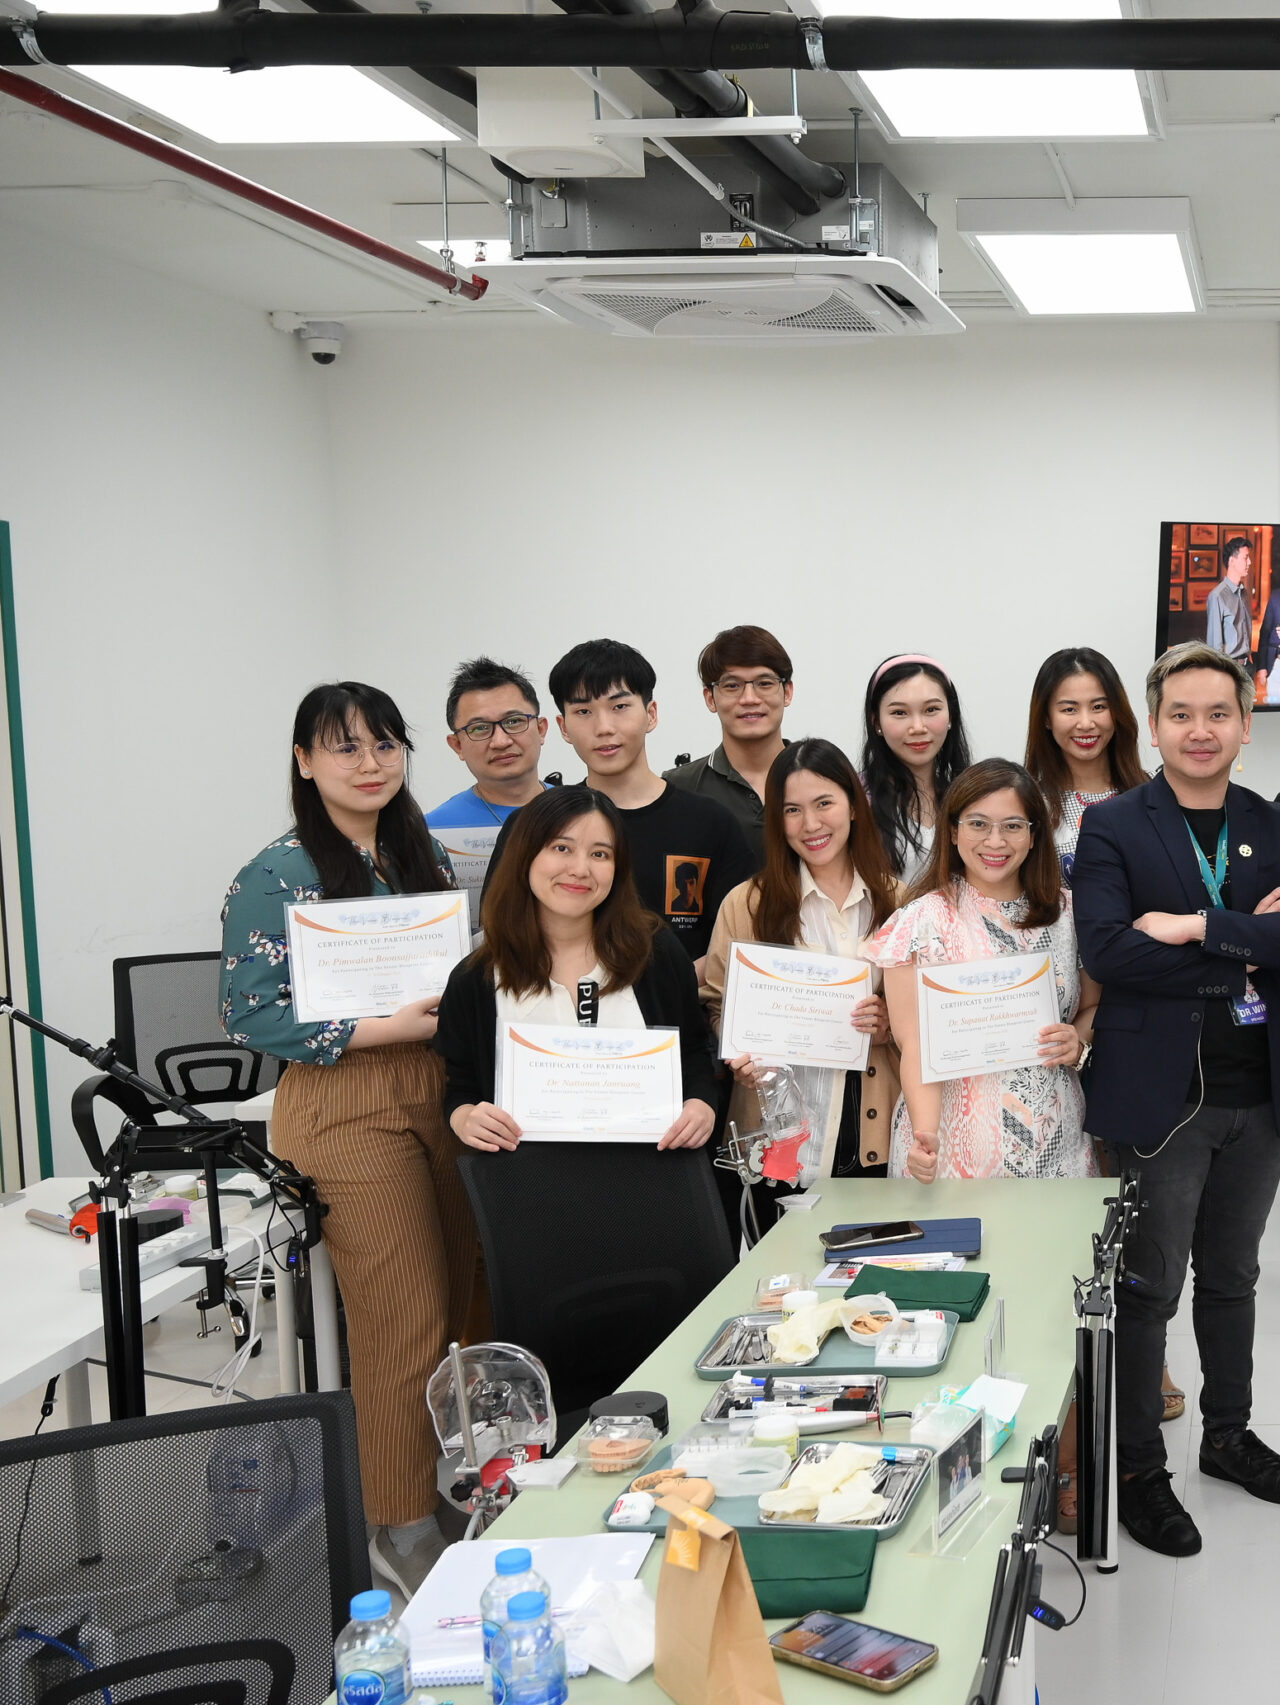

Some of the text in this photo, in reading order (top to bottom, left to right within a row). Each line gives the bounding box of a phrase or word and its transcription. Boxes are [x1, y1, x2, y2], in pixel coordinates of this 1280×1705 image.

[317, 939, 369, 949] CERTIFICATE
[383, 932, 444, 943] PARTICIPATION
[318, 958, 330, 967] Dr.
[750, 983, 793, 994] CERTIFICATE
[806, 989, 855, 1000] PARTICIPATION
[940, 999, 982, 1010] CERTIFICATE
[994, 990, 1040, 1002] PARTICIPATION
[529, 1061, 656, 1071] CERTIFICATE OF PARTICIPATION
